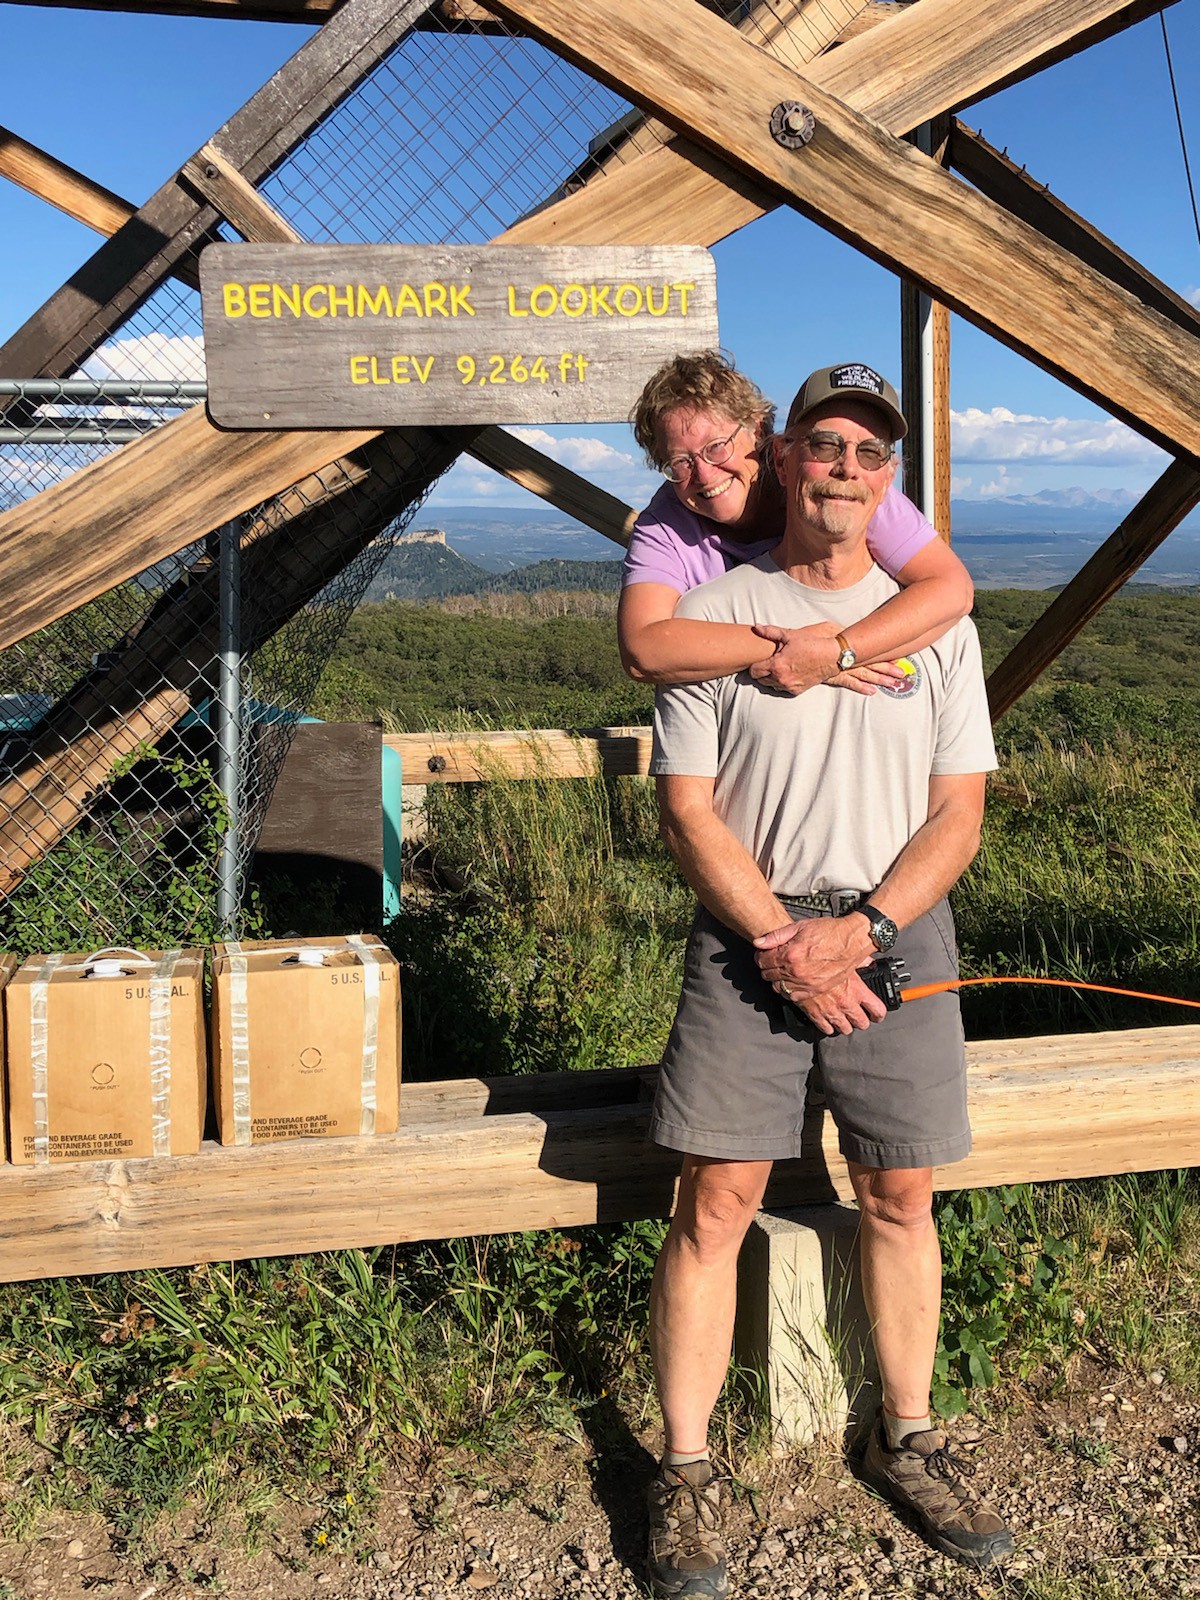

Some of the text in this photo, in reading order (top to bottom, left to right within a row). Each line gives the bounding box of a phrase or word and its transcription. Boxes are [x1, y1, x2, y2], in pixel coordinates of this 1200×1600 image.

[222, 282, 697, 318] BENCHMARK LOOKOUT
[350, 353, 589, 387] ELEV 9,264 ft
[837, 380, 880, 394] FIREFIGHTER
[332, 972, 363, 985] 5 U.S.
[125, 988, 132, 999] 5
[167, 985, 189, 997] AL.
[268, 1116, 303, 1124] BEVERAGE
[305, 1114, 328, 1122] GRADE
[256, 1123, 298, 1132] CONTAINERS
[60, 1134, 97, 1142] BEVERAGE
[98, 1132, 122, 1140] GRADE
[252, 1131, 270, 1139] FOOD
[272, 1130, 287, 1138] AND
[48, 1142, 92, 1150] CONTAINERS
[103, 1140, 113, 1148] BE
[114, 1139, 133, 1147] USED
[47, 1150, 63, 1158] OOD
[81, 1147, 123, 1156] BEVERAGES
